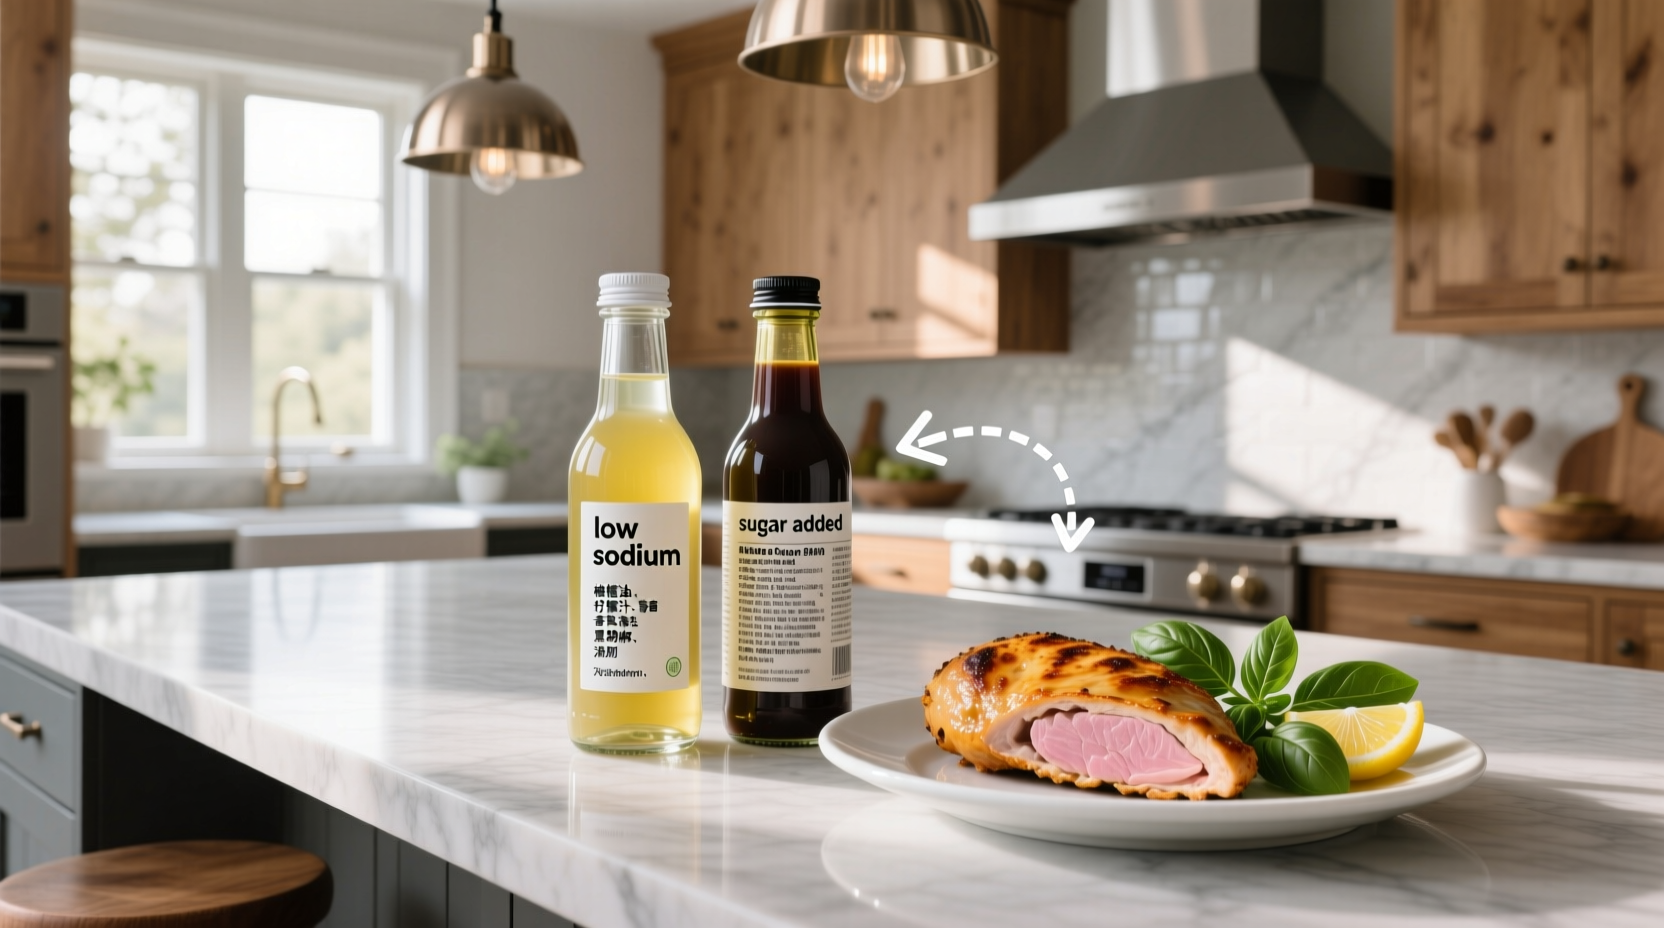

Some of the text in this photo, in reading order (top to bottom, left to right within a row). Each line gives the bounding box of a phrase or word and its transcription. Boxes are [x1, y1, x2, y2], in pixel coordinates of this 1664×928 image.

[594, 515, 639, 540] low
[739, 513, 843, 538] sugar added
[593, 543, 681, 567] sodium
